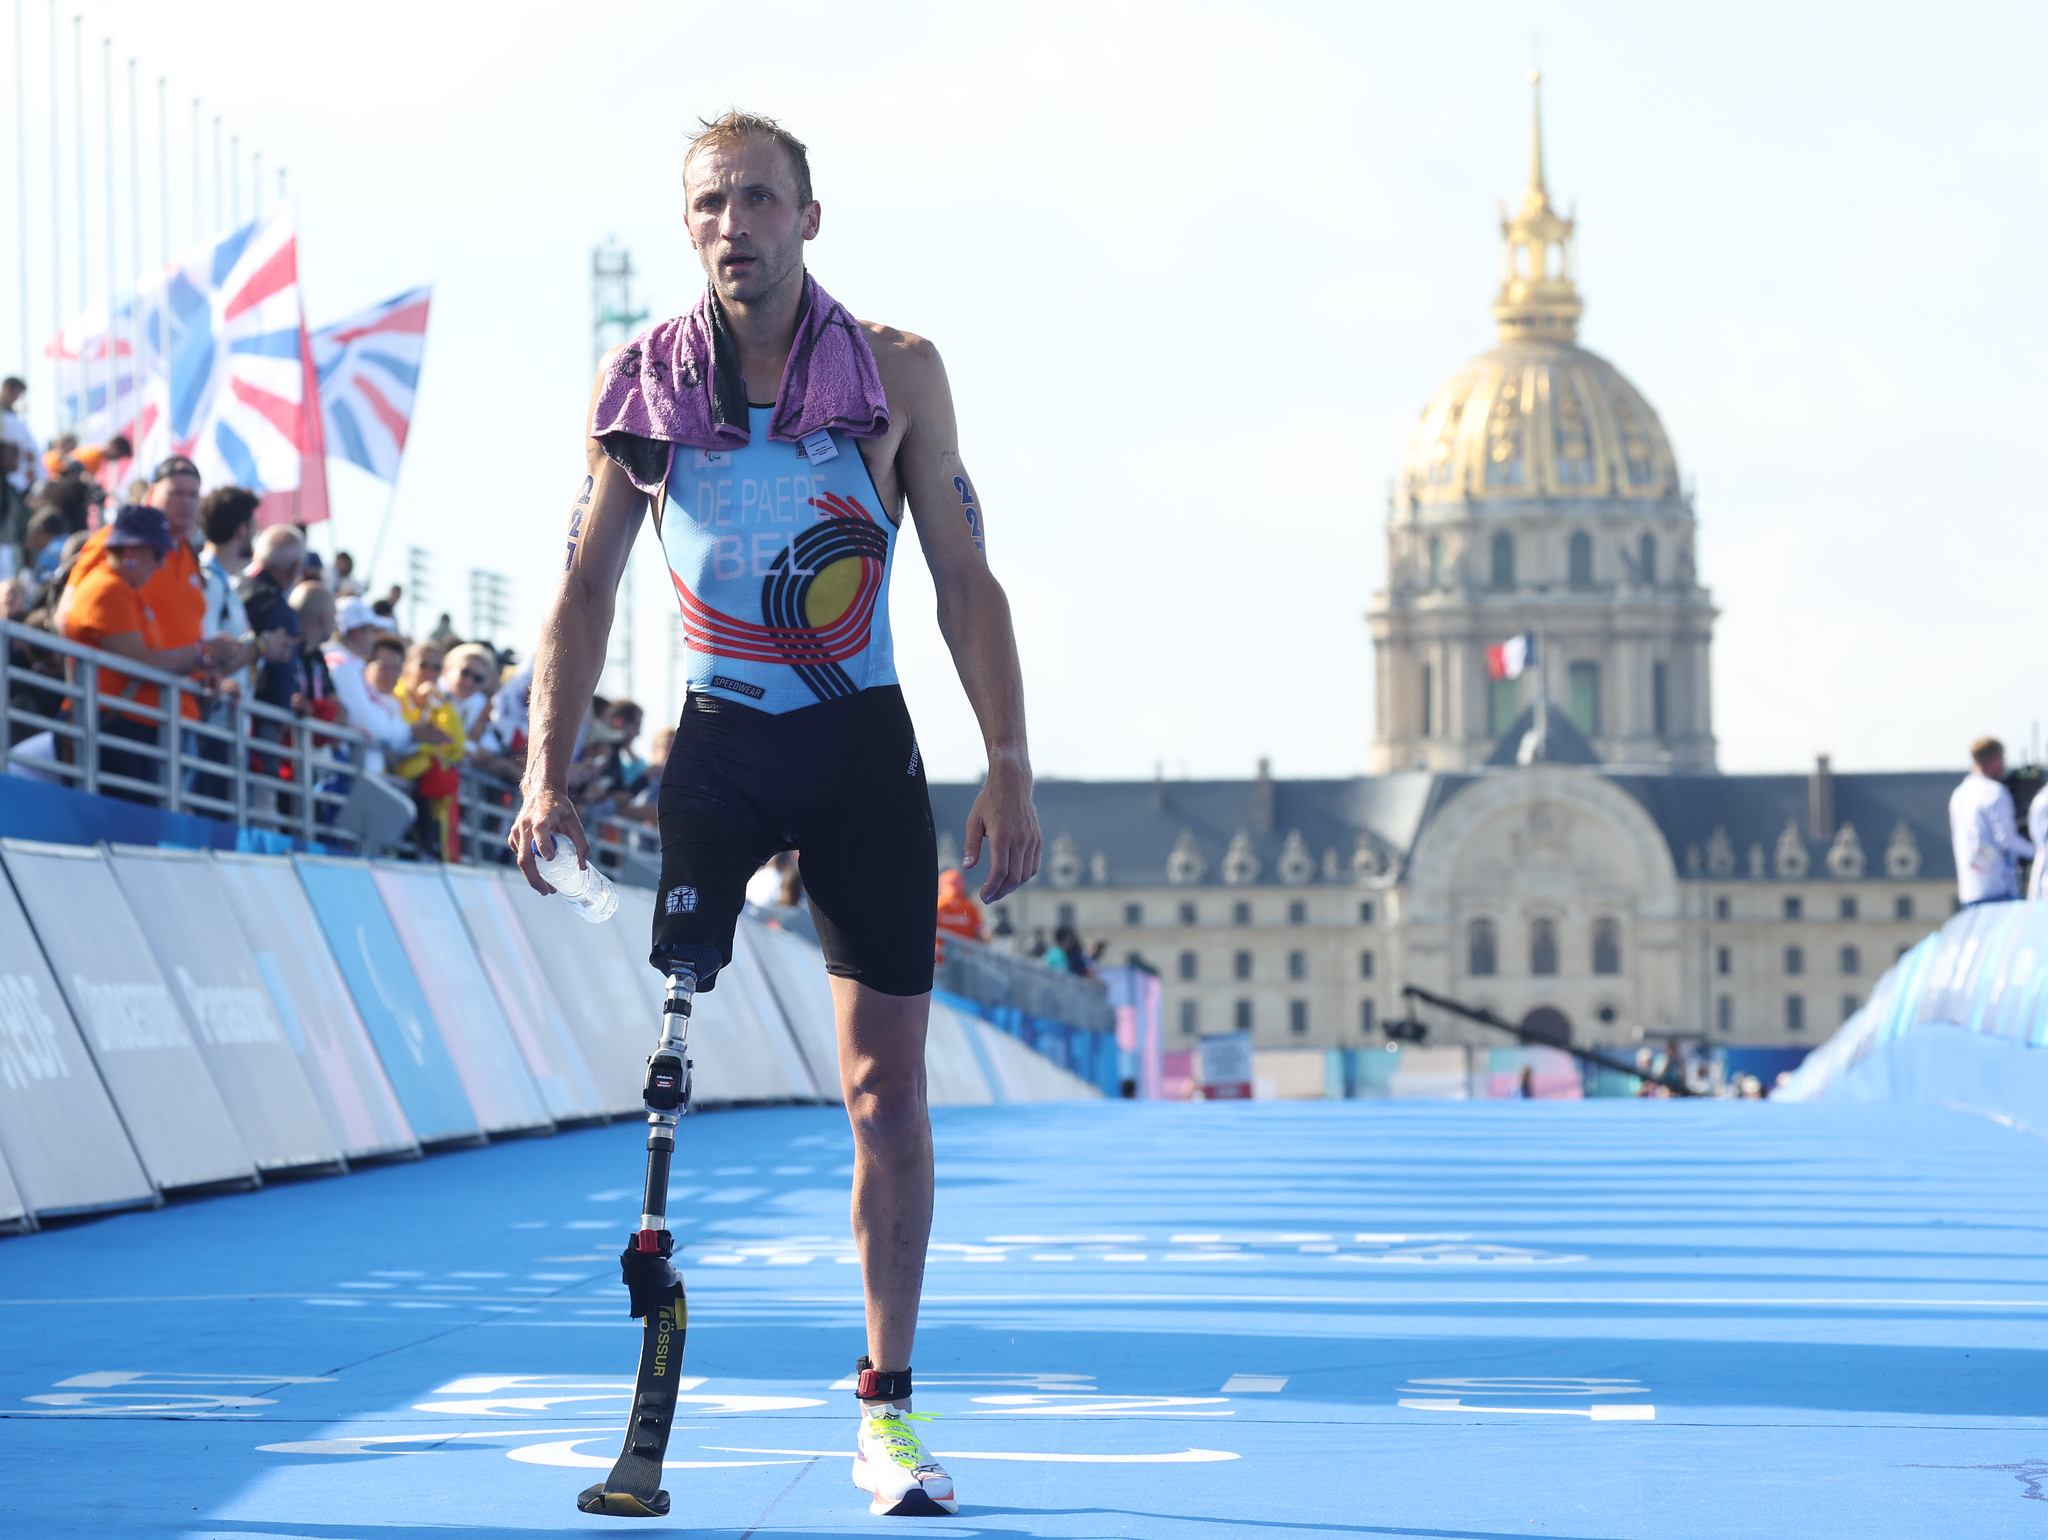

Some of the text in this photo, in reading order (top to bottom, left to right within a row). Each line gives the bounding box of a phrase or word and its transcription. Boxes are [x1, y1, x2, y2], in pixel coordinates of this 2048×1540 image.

[565, 475, 594, 572] 221
[697, 474, 831, 529] DE PAEPE
[713, 532, 815, 581] BEL
[713, 677, 762, 698] SPEEDWEAR
[653, 1320, 675, 1376] ÖSSUR
